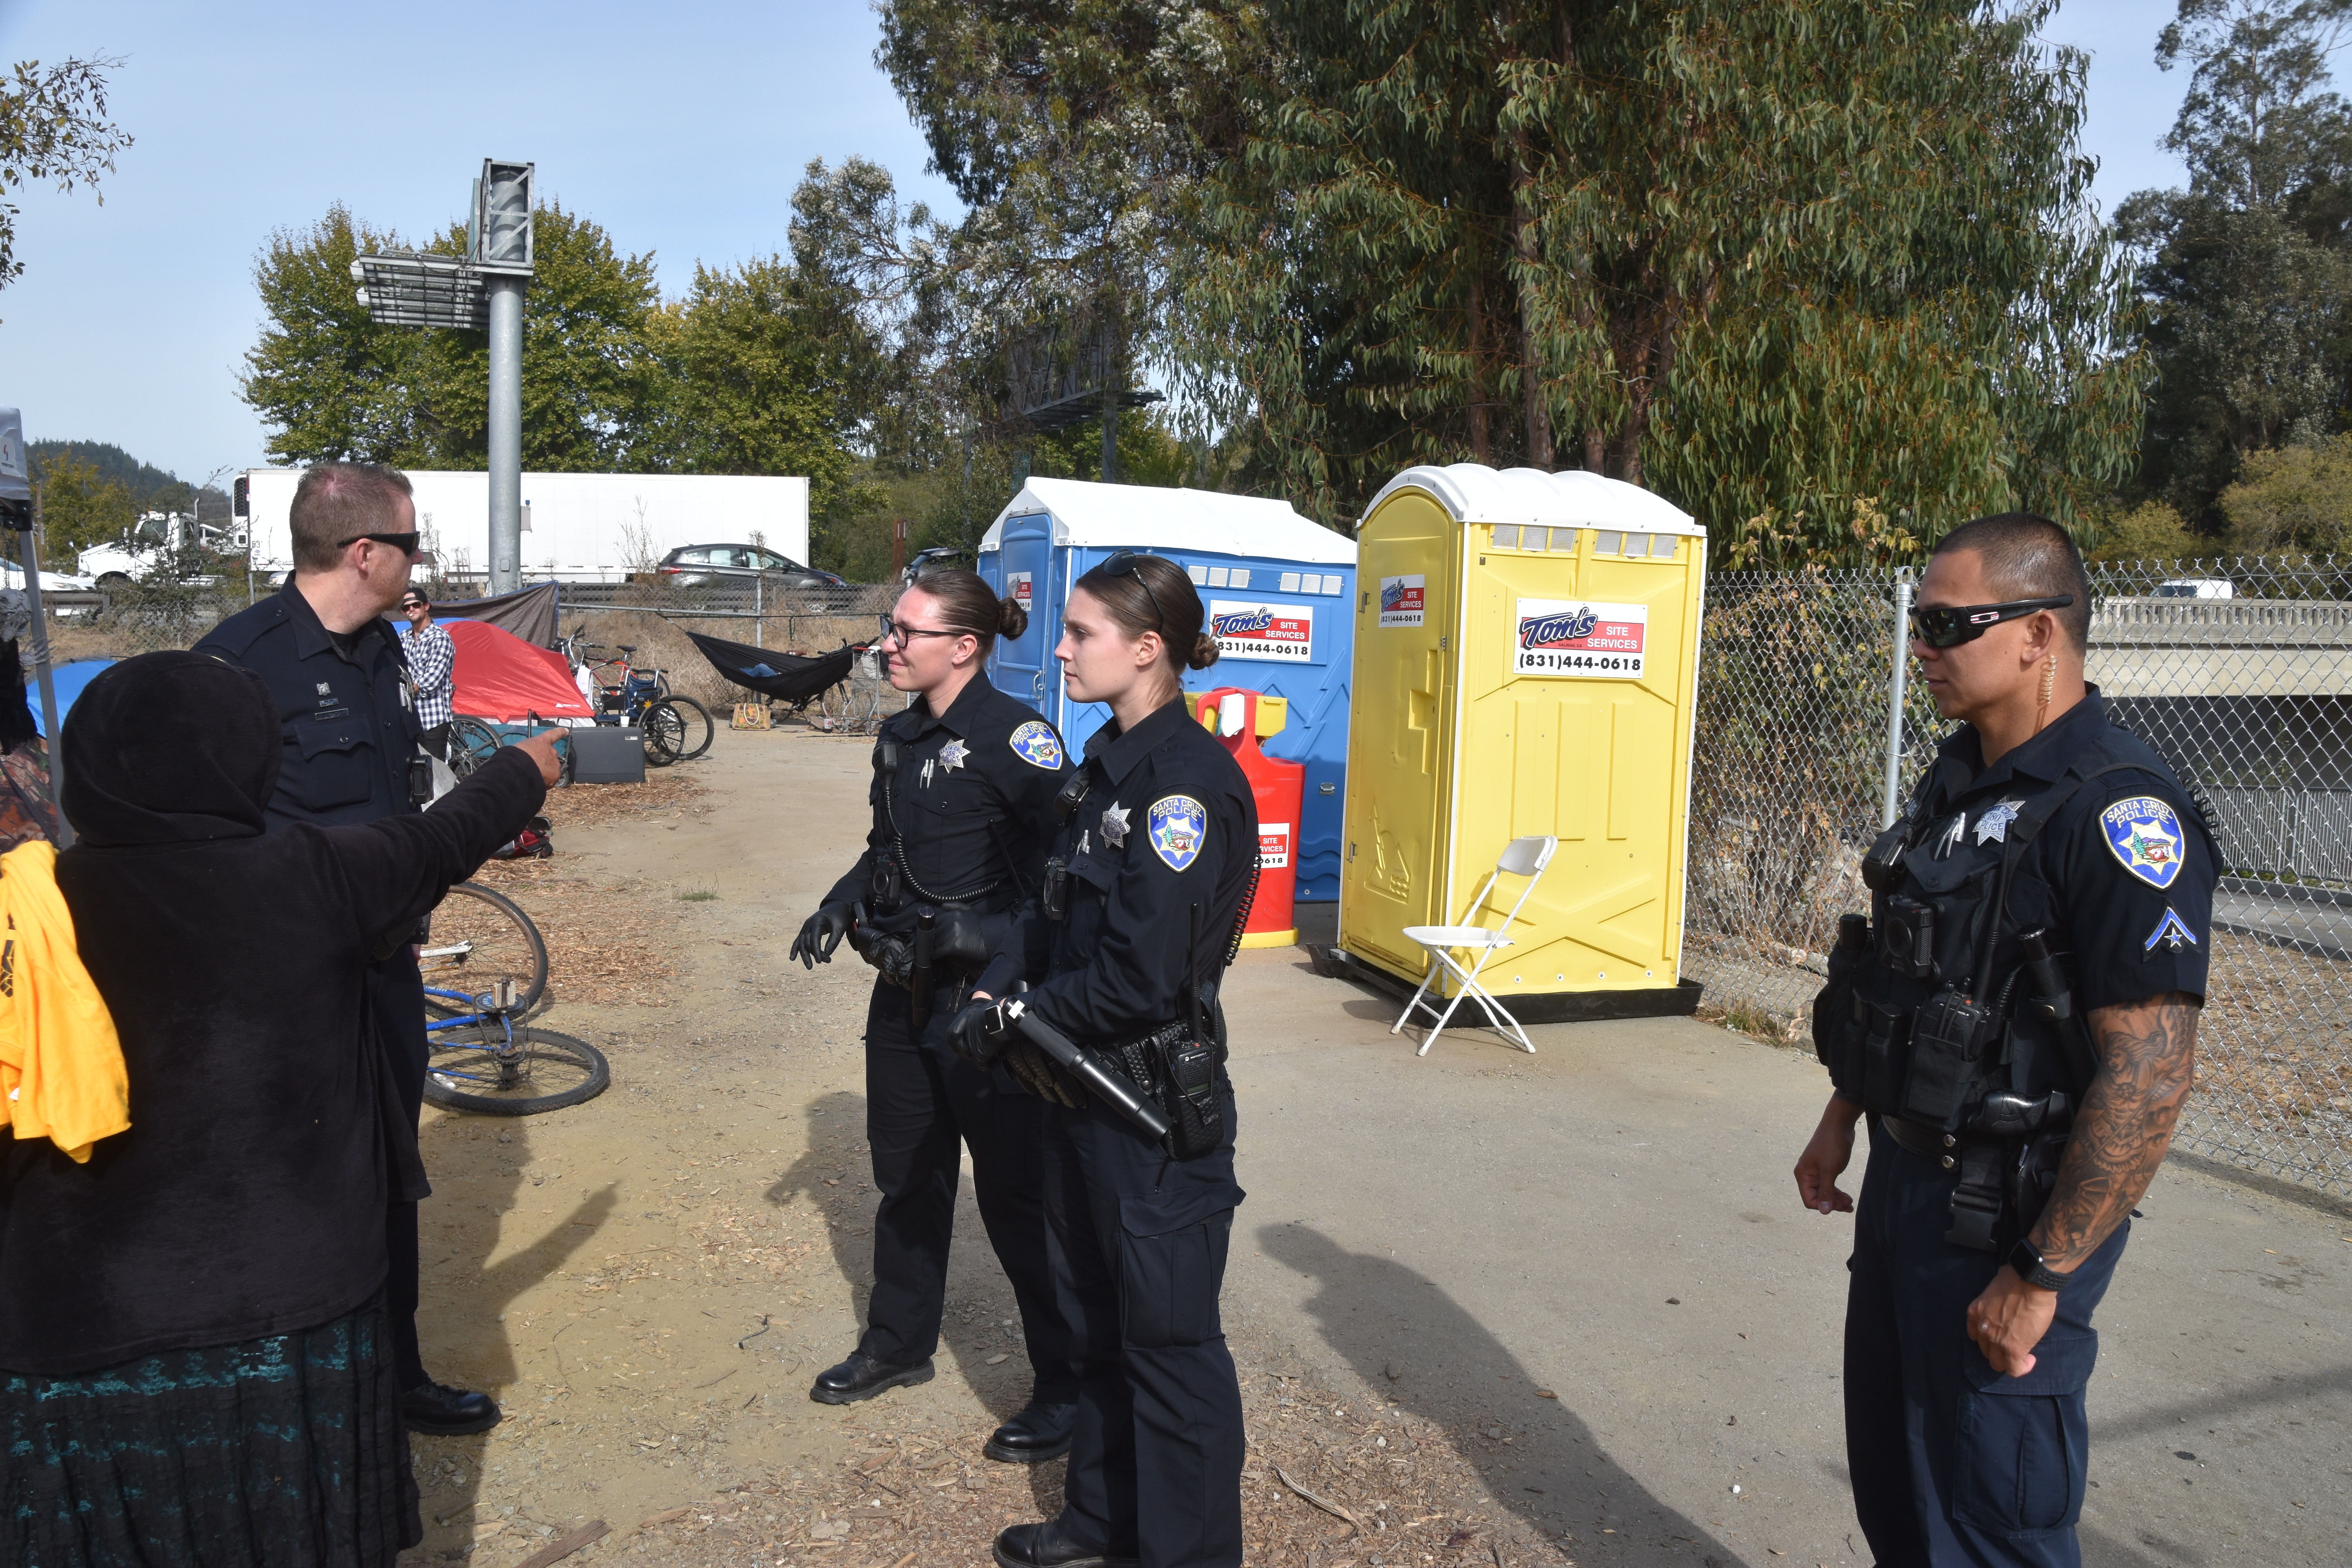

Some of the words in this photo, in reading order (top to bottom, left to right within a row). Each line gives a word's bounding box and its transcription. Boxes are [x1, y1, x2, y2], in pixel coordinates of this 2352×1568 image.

[1381, 579, 1405, 612] Tom's
[1214, 607, 1274, 637] Tom's
[1381, 615, 1421, 623] (831)444-0618
[1265, 630, 1305, 639] SERVICES
[1521, 607, 1598, 649] Tom's
[1606, 626, 1628, 636] SITE
[1217, 641, 1308, 655] 831)444-0618
[1587, 638, 1637, 649] SERVICES
[1520, 653, 1641, 671] (831)444-0618
[1013, 726, 1029, 745] SANTA
[1019, 728, 1046, 746] POLICE
[940, 746, 952, 754] SANTA
[954, 747, 964, 756] CRUZ
[1153, 799, 1179, 816] SANTA
[1181, 799, 1202, 817] CRUZ
[1159, 806, 1197, 822] POLICE
[2107, 800, 2140, 823] SANTA
[2142, 800, 2172, 819] CRUZ
[1115, 818, 1125, 833] CRUZ
[1987, 812, 2001, 822] 180
[2117, 808, 2169, 828] POLICE
